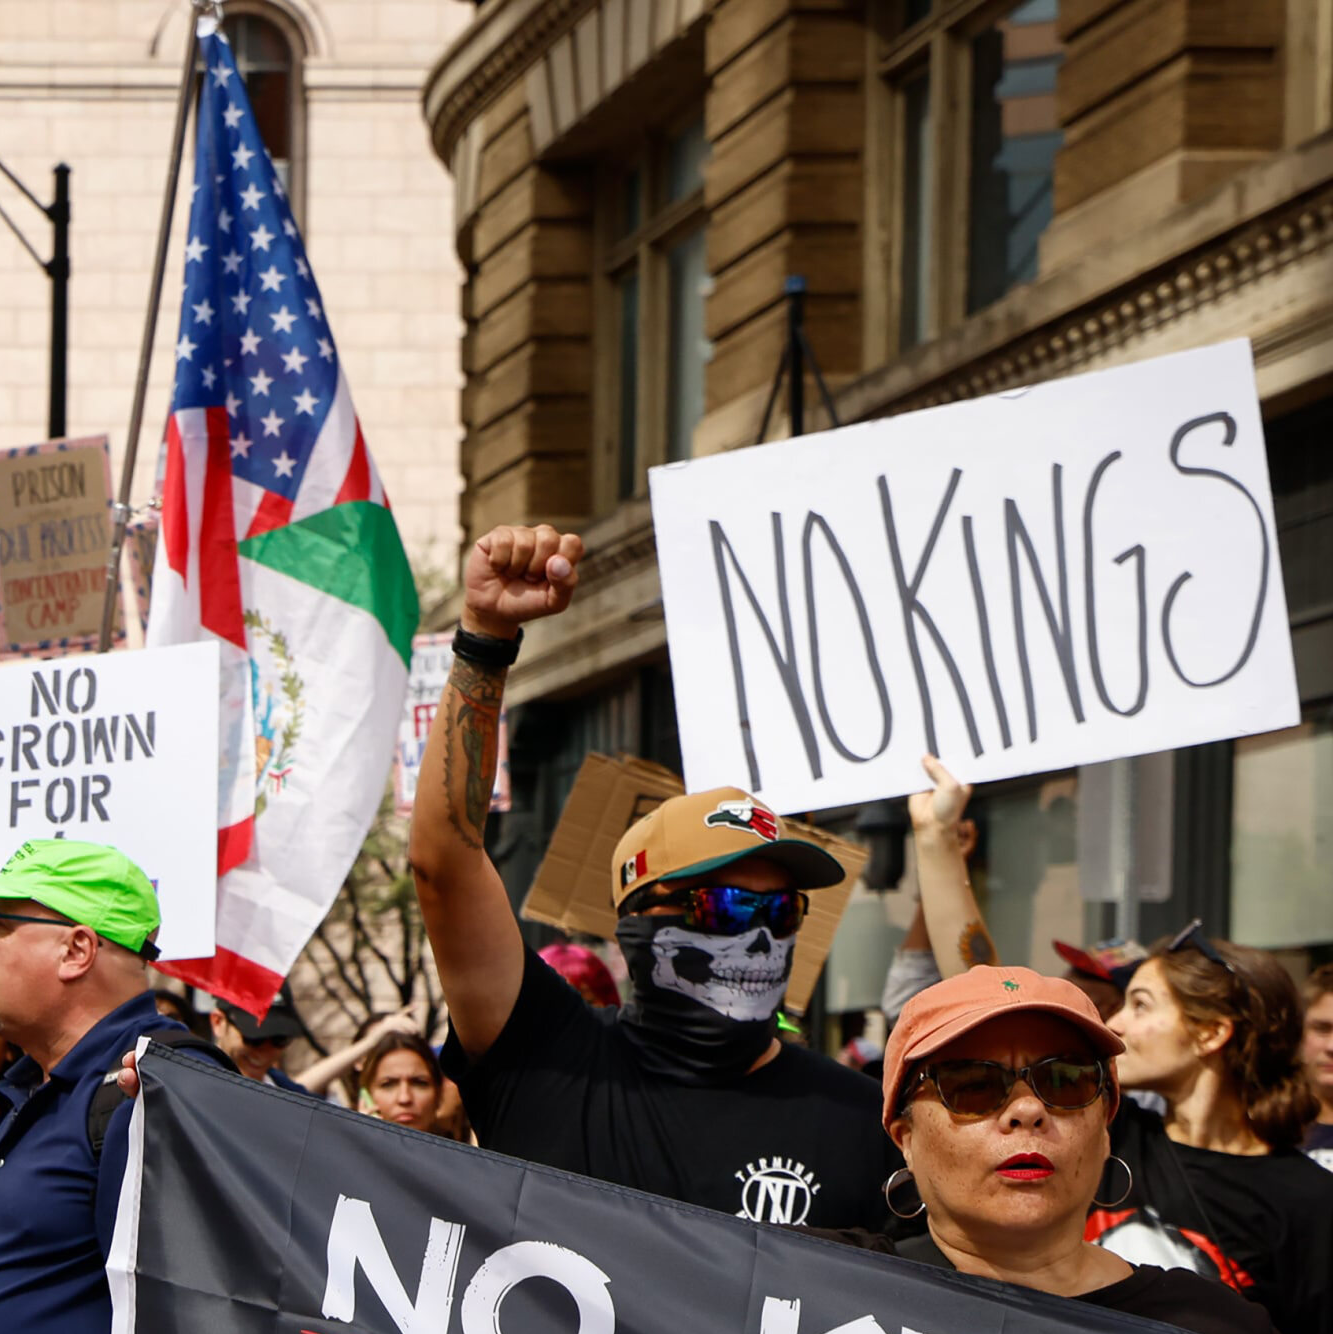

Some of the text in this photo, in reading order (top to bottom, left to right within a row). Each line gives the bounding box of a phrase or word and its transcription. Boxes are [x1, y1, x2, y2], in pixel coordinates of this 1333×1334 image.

[12, 462, 86, 507] PRISON
[709, 411, 1271, 793] NO KINGS
[30, 667, 98, 718] NO
[9, 774, 112, 828] FOR
[734, 1156, 821, 1195] TERMINAL
